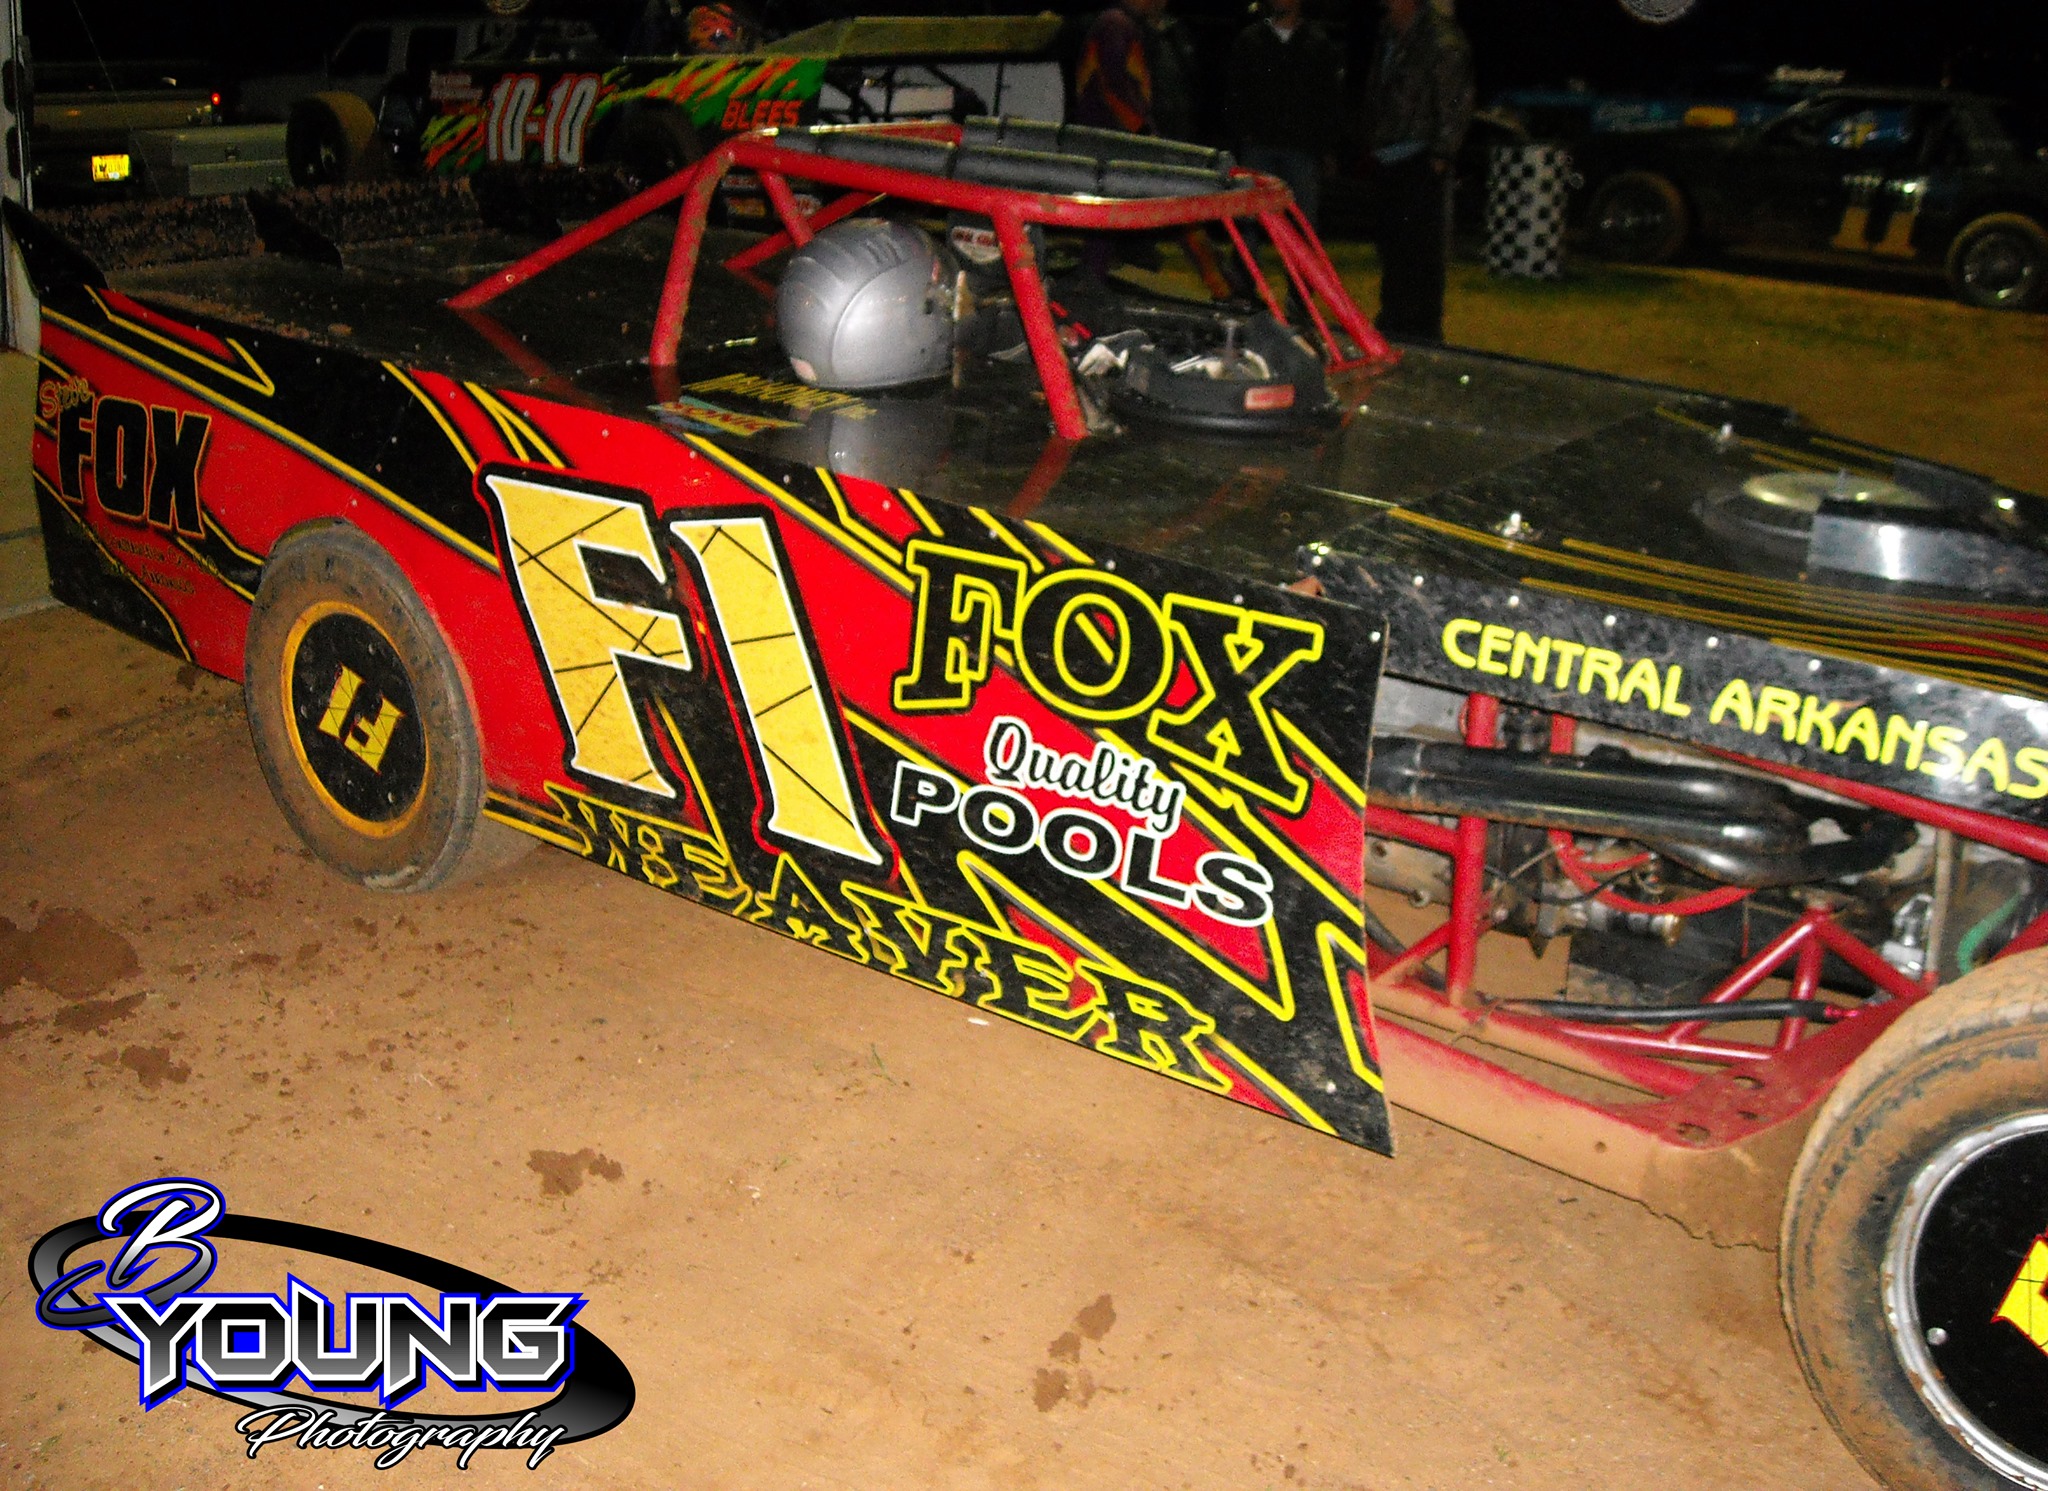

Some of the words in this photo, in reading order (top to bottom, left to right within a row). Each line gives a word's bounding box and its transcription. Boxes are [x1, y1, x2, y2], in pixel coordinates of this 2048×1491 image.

[487, 73, 602, 167] 10-10
[721, 98, 804, 130] BLEES
[57, 393, 211, 539] FOX
[893, 540, 1324, 812] FOX
[1442, 618, 1691, 718] CENTRAL
[1708, 678, 2048, 801] ARKANSAS
[891, 760, 1275, 928] POOLS
[984, 715, 1186, 838] Quality
[544, 780, 1232, 1094] WEAVER
